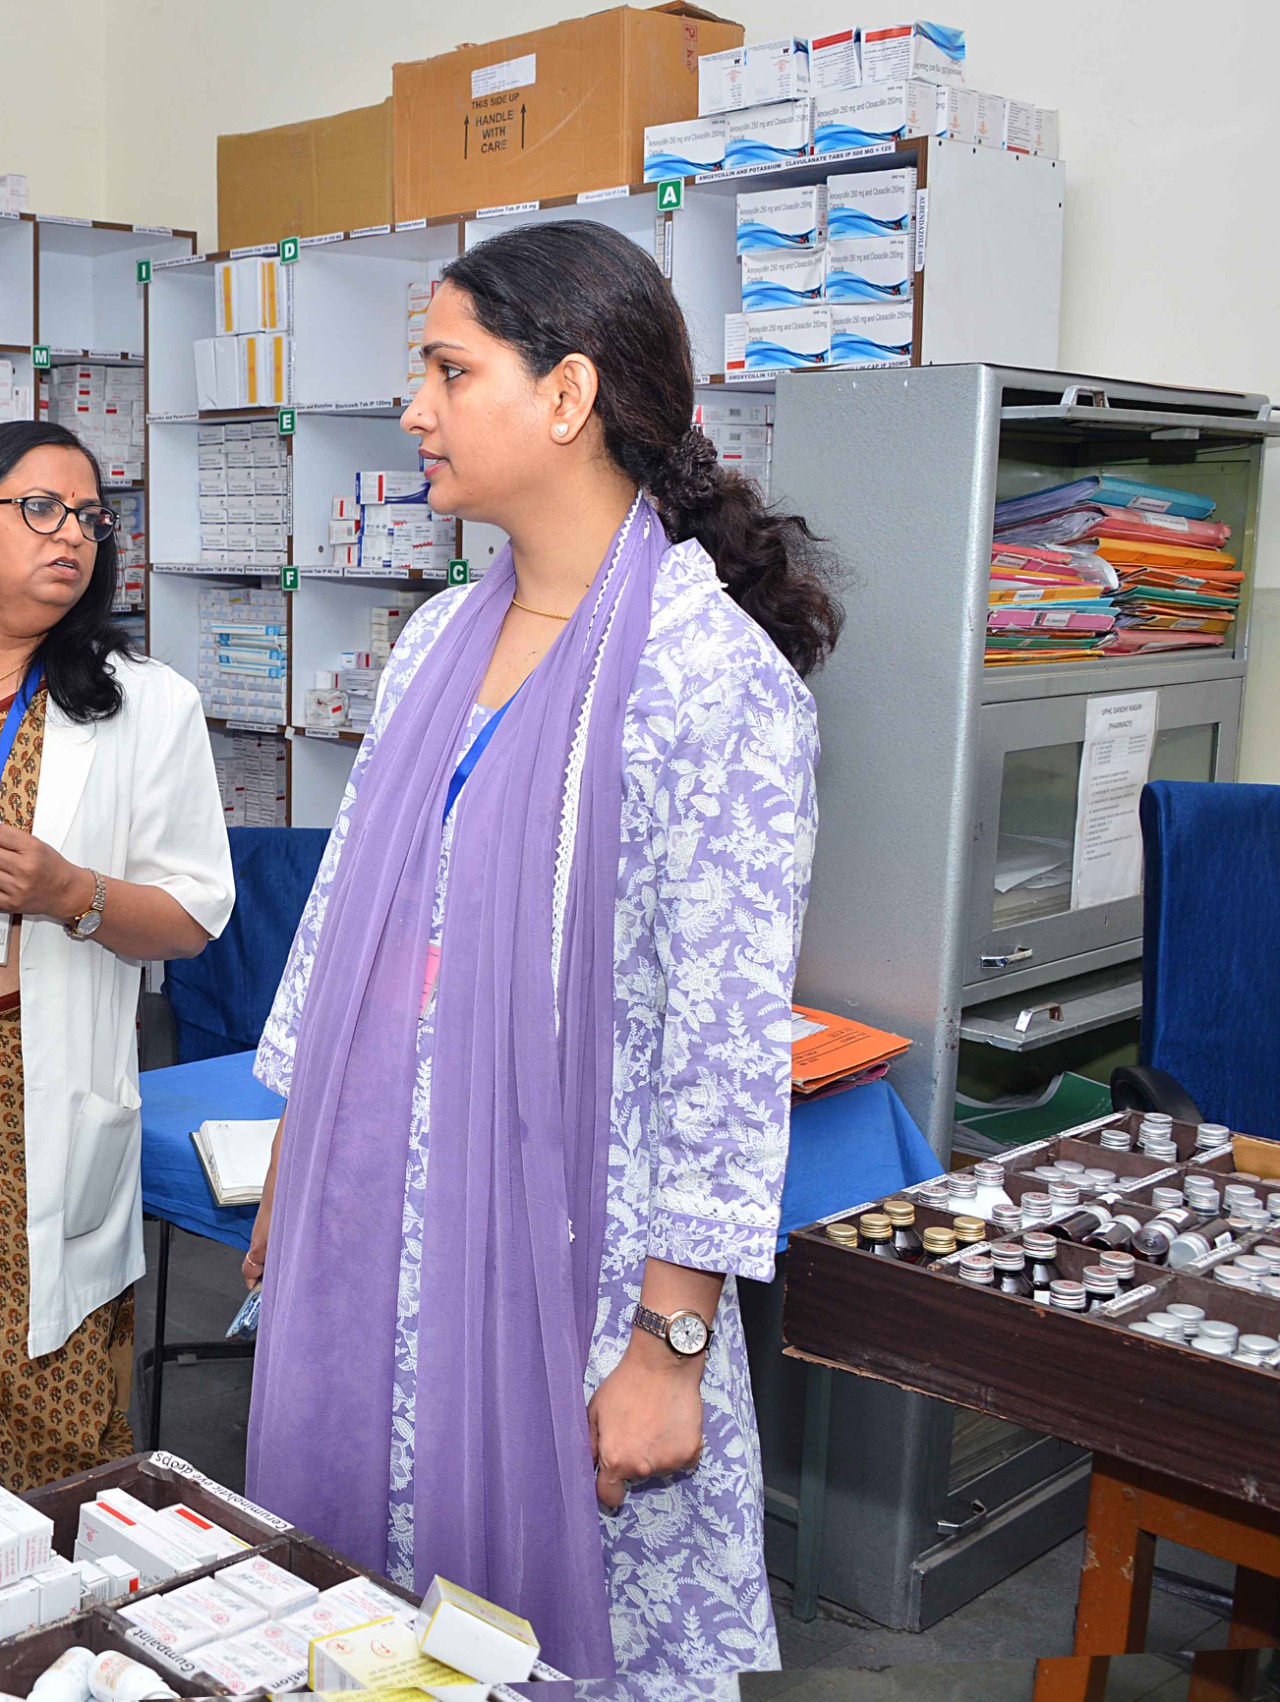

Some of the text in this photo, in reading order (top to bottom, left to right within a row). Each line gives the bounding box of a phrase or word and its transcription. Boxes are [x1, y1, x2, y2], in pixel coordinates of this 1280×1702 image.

[472, 92, 520, 110] THIS SIDE UP
[476, 110, 514, 127] HANDLE
[482, 126, 506, 140] WITH
[481, 139, 507, 154] CARE
[699, 170, 735, 181] AMOXYCILLIN
[736, 168, 748, 176] AND
[749, 163, 782, 174] POTASSIUM
[786, 156, 827, 167] CLAVULANATE
[662, 186, 678, 205] A
[918, 196, 926, 249] ALBENDAZOLE
[285, 243, 295, 259] D
[35, 352, 47, 363] M
[728, 373, 766, 381] AMOXYCILLIN
[283, 416, 292, 429] E
[286, 572, 295, 586] F
[453, 564, 465, 582] C
[155, 1451, 288, 1532] Ceruminolytic eye drops
[132, 1632, 196, 1673] Gumpaint
[272, 1668, 308, 1690] ation
